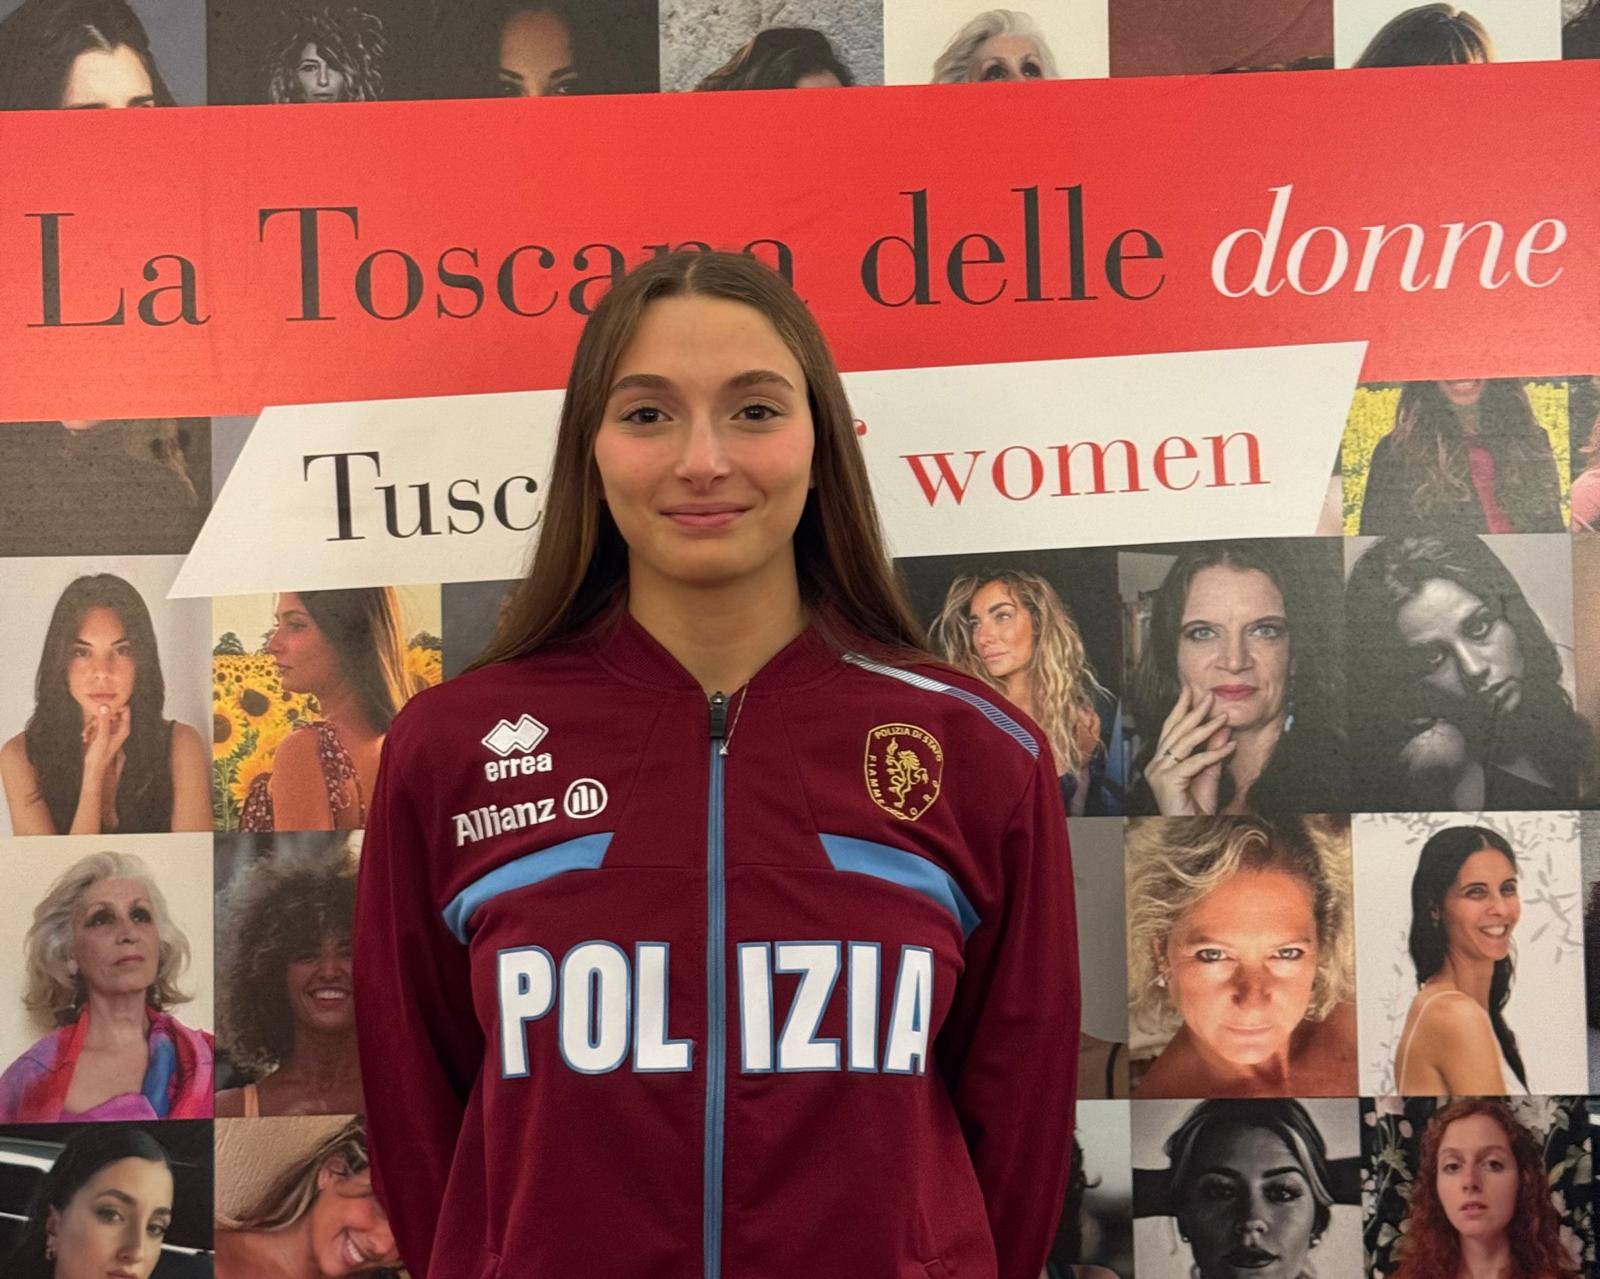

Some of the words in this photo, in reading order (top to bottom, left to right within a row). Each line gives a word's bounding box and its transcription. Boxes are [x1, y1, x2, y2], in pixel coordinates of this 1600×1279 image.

[24, 212, 210, 328] La
[258, 206, 808, 320] Tosca
[860, 184, 1166, 308] delle
[1210, 184, 1567, 300] donne
[303, 452, 542, 542] Tusc
[900, 430, 1271, 508] women
[874, 727, 911, 739] POLIZIA
[451, 798, 556, 847] Allianz
[497, 940, 934, 1078] POLIZIA
